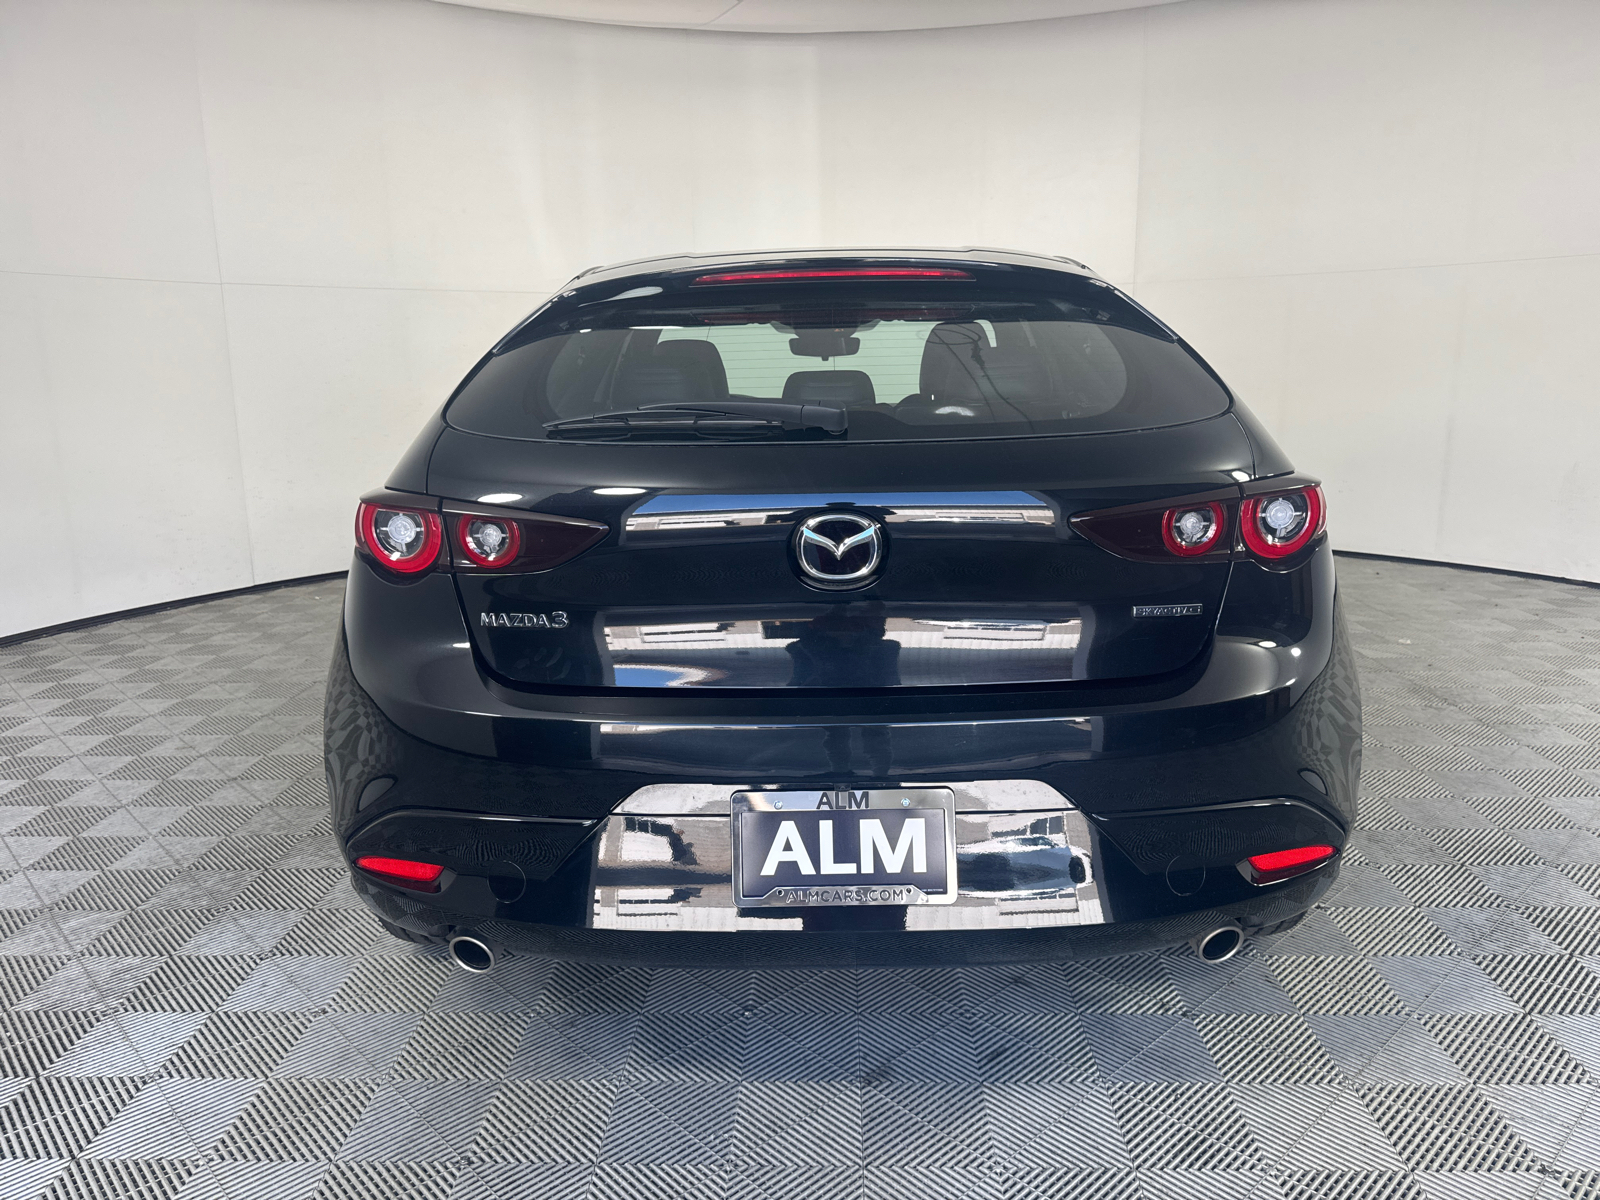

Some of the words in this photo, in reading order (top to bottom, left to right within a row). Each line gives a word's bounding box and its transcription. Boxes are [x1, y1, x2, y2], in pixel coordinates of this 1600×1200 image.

[480, 610, 569, 628] MAZDA3
[816, 791, 870, 809] ALM
[760, 818, 927, 876] ALM
[786, 889, 904, 904] ALMCARS.COM
